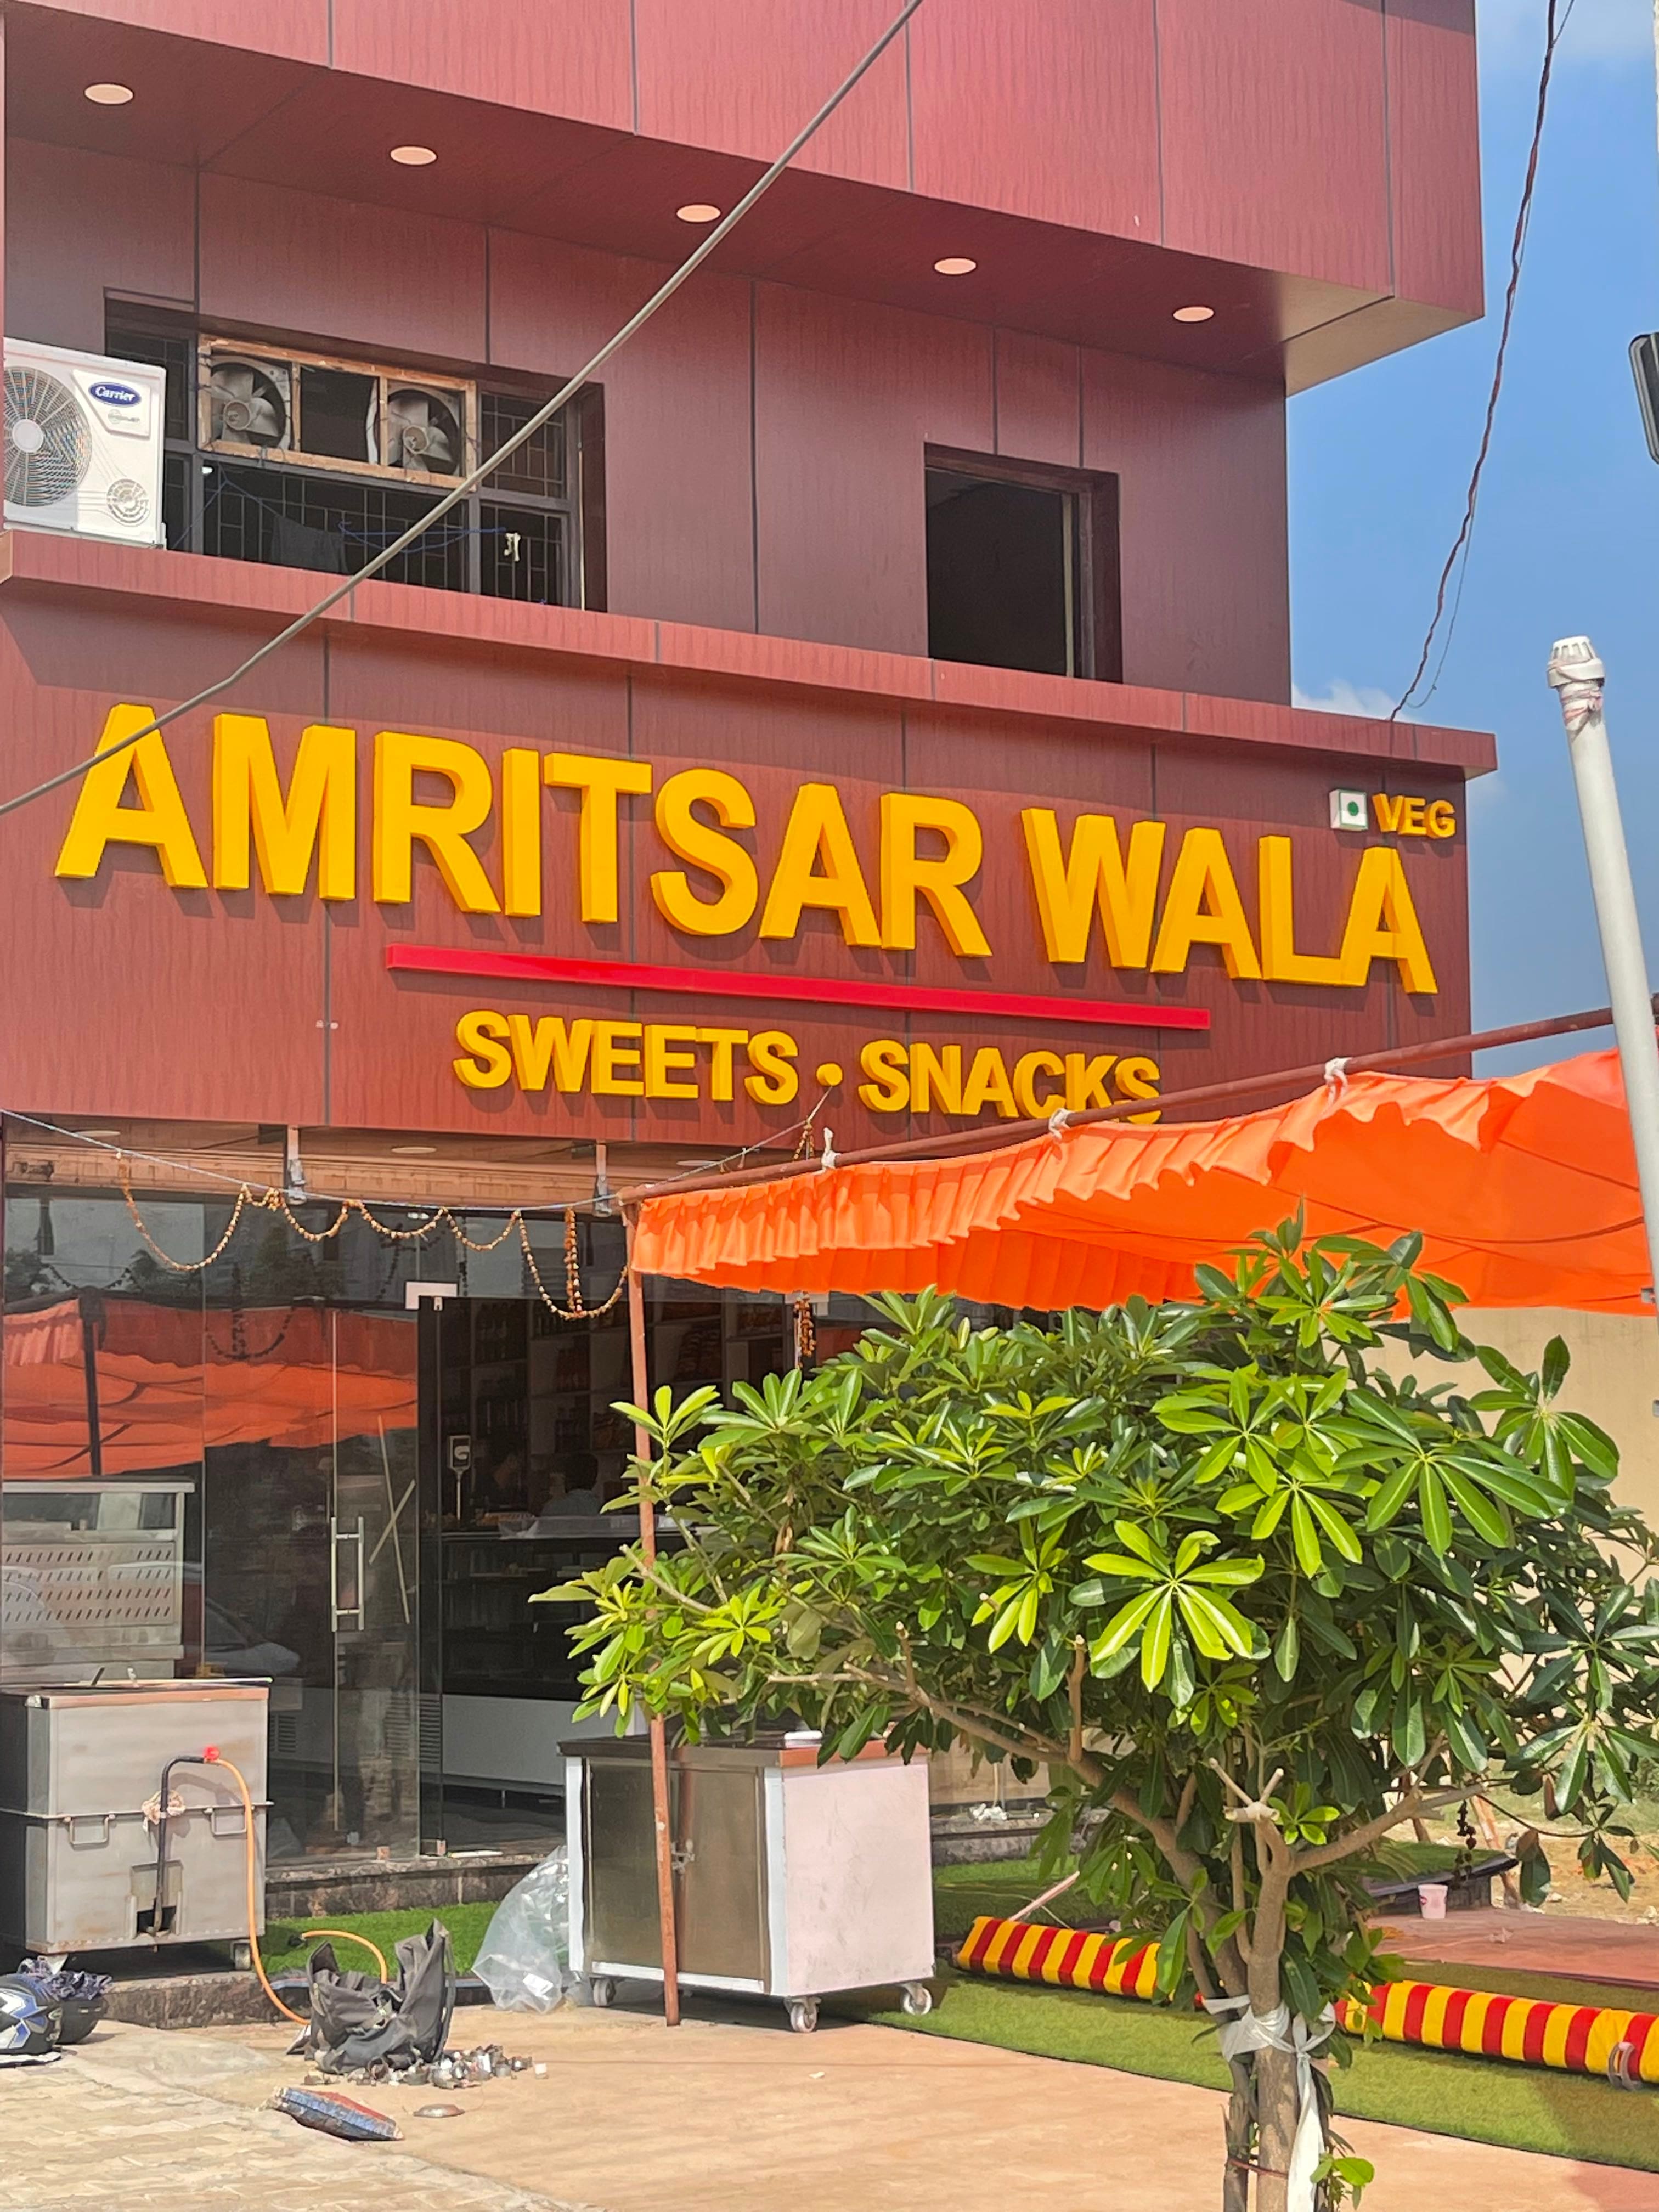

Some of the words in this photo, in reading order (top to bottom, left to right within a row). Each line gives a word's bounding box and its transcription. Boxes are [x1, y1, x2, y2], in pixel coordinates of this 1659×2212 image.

[95, 386, 136, 402] Carrier
[55, 702, 992, 957] AMRITSAR
[1021, 808, 1438, 995] WALA
[1372, 793, 1456, 839] VEG
[453, 1010, 799, 1105] SWEETS
[857, 1039, 1163, 1125] SNACKS
